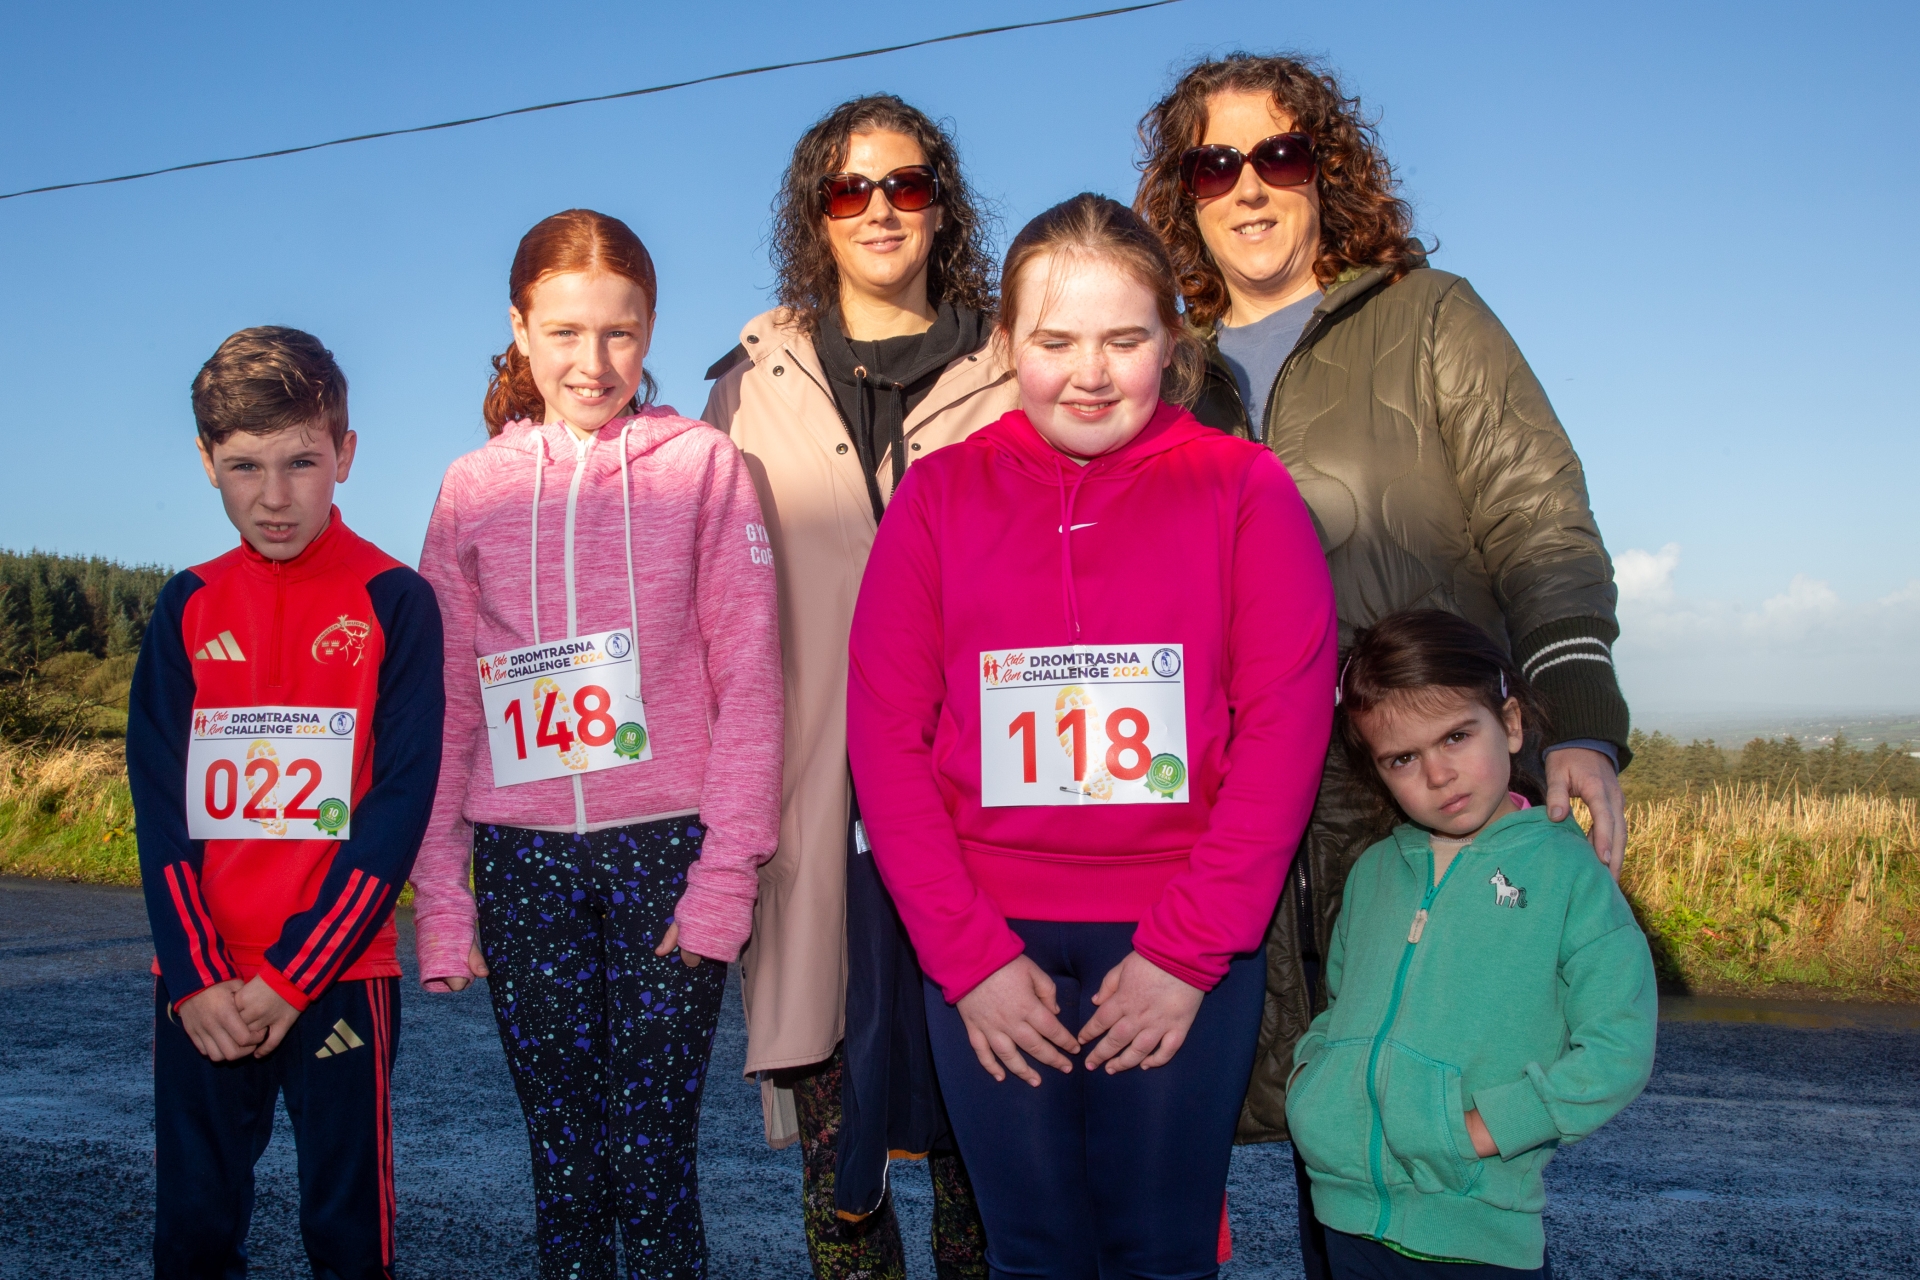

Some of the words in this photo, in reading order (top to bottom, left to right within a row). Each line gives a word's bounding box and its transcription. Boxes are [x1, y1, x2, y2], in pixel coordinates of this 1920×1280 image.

[510, 641, 596, 666] DROMTRASNA
[1002, 652, 1025, 668] Kids
[1029, 652, 1141, 668] DROMTRASNA
[492, 655, 508, 668] Kids
[507, 659, 571, 679] CHALLENGE
[573, 651, 605, 666] 2024
[493, 669, 508, 682] Run
[1000, 668, 1023, 684] Run
[1022, 667, 1110, 682] CHALLENGE
[1113, 666, 1150, 678] 2024
[210, 711, 230, 723] Kids
[231, 712, 321, 724] DROMTRASNA
[504, 684, 617, 760] 148
[207, 723, 224, 736] Run
[224, 724, 293, 735] CHALLENGE
[295, 725, 327, 735] 2024
[626, 731, 637, 741] 10
[1008, 707, 1152, 784] 118
[1161, 764, 1174, 777] 10
[204, 758, 323, 820] 022
[328, 807, 339, 818] 10
